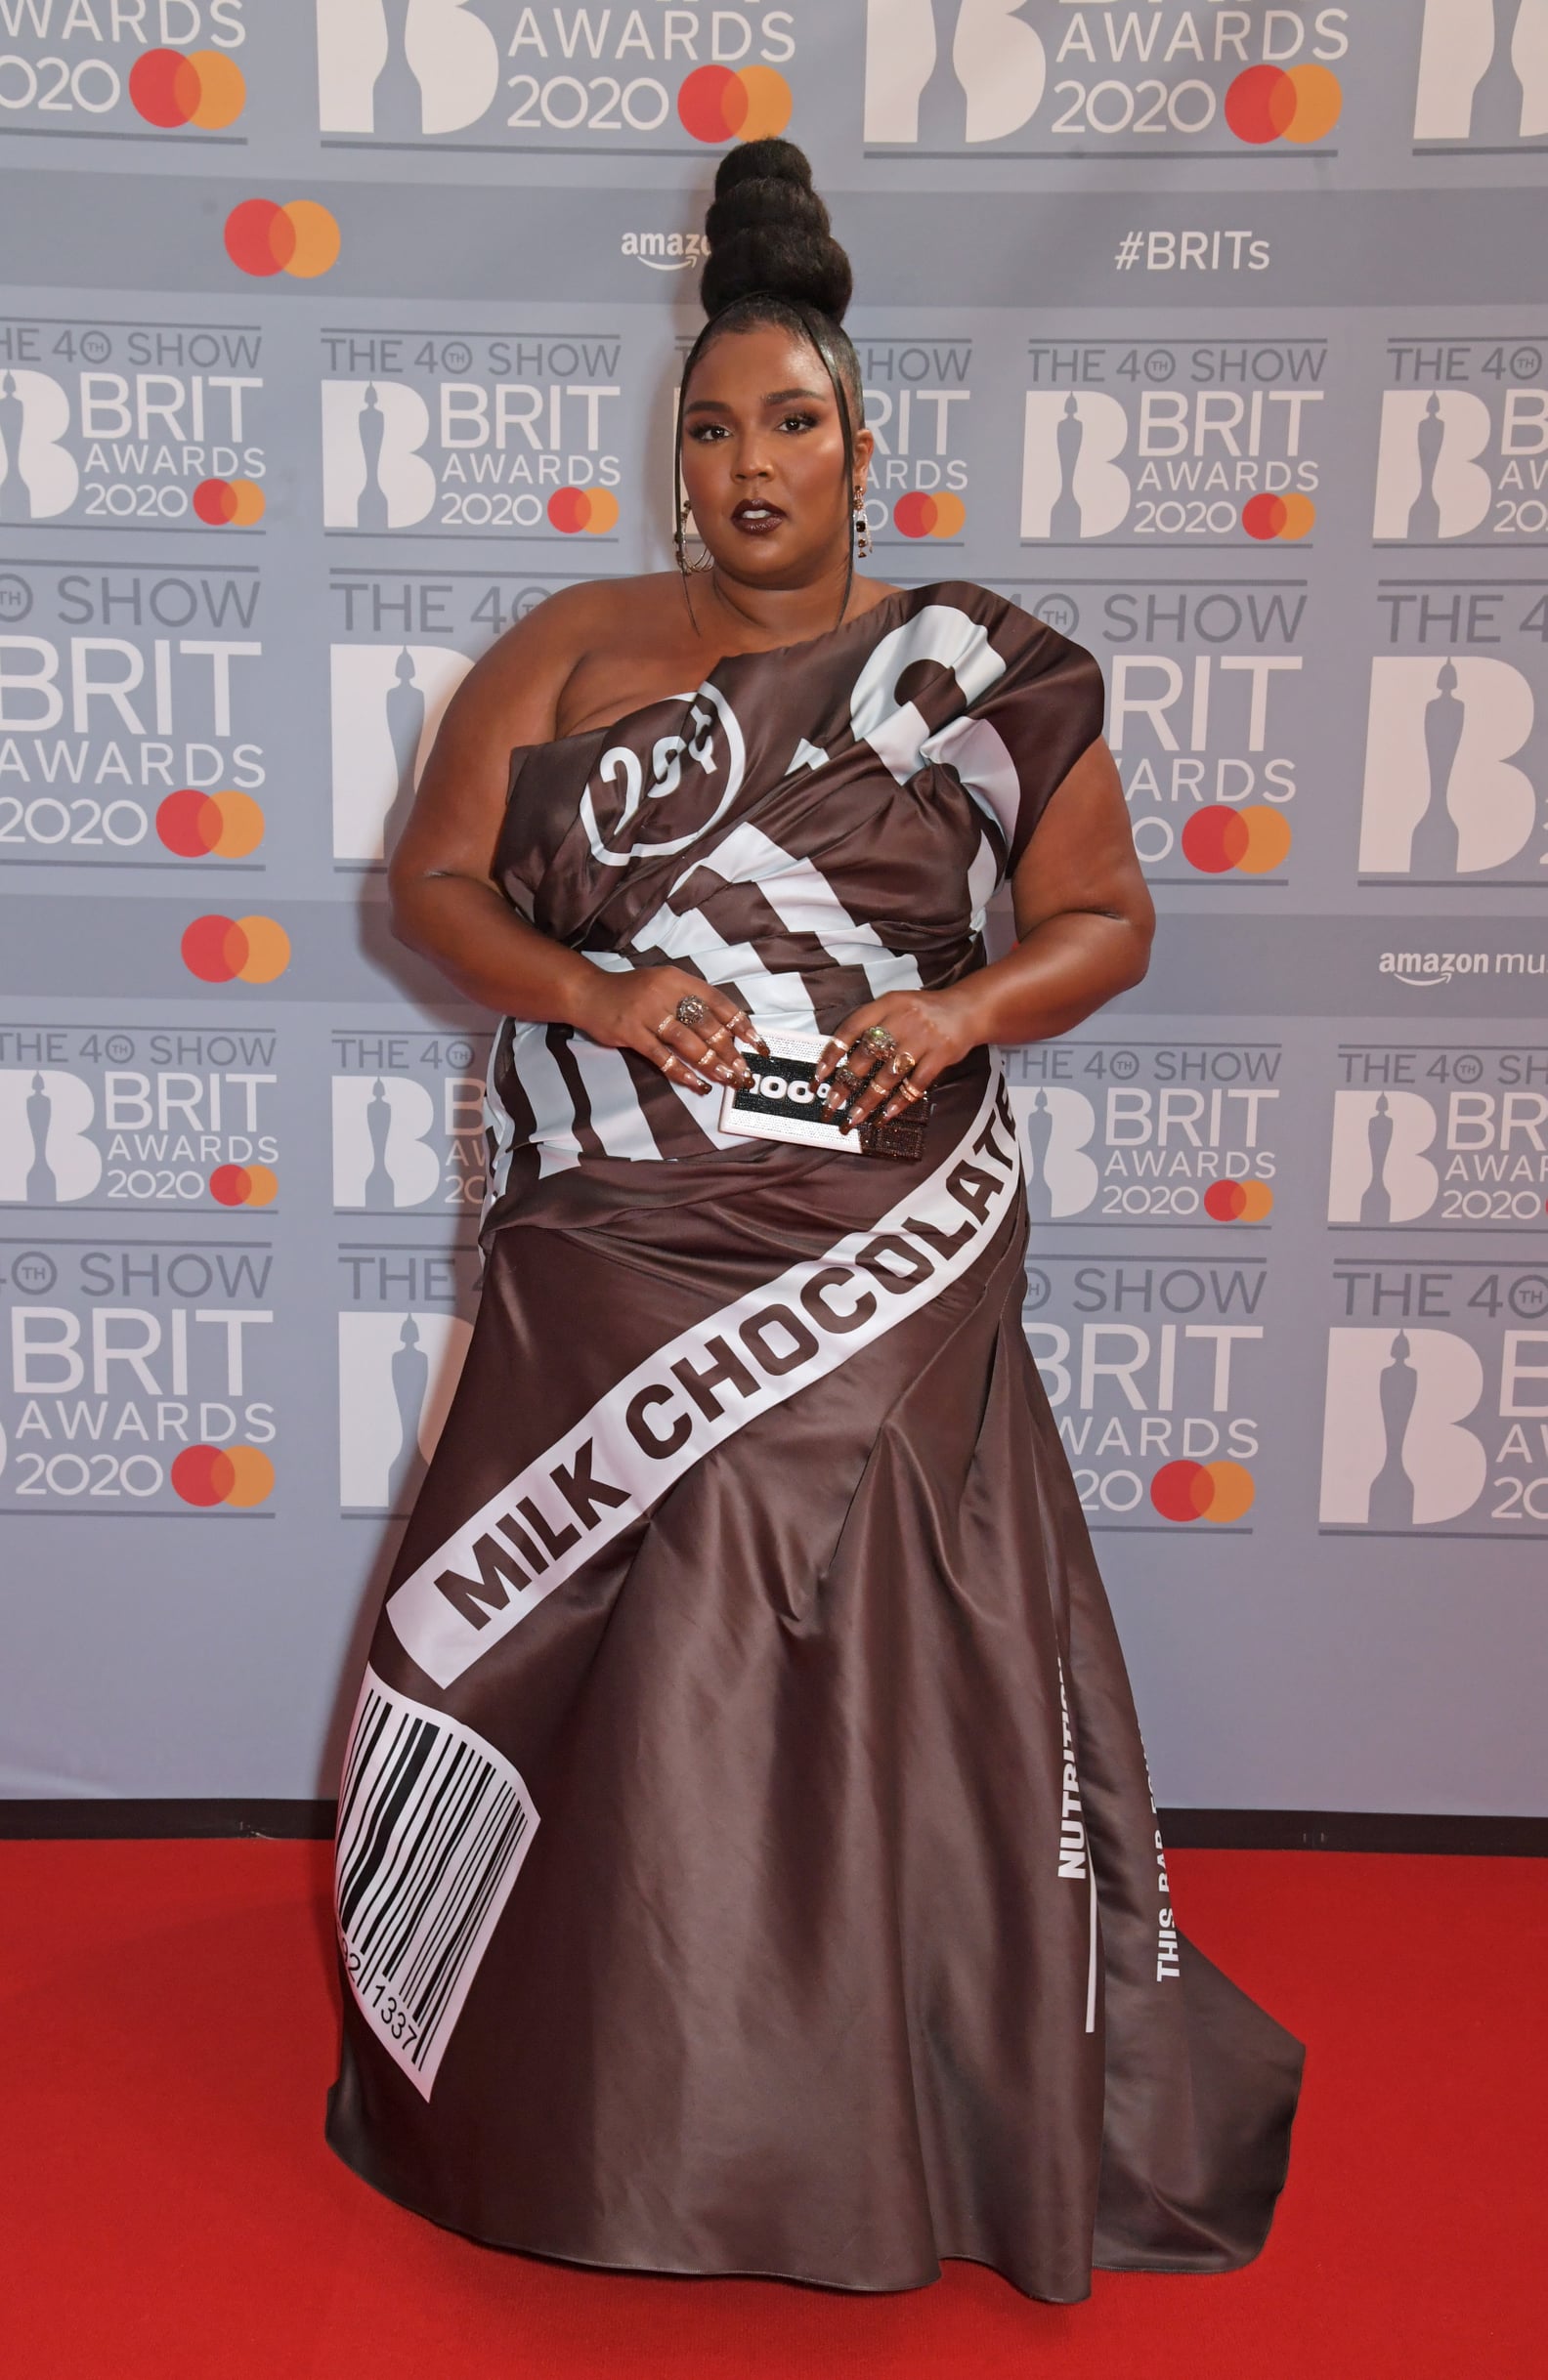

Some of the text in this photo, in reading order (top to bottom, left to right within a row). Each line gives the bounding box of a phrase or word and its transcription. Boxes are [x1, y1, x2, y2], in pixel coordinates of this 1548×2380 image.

[508, 8, 796, 63] AWARDS
[1055, 8, 1349, 63] AWARDS
[507, 74, 669, 131] 2020
[1051, 79, 1217, 134] 2020
[1114, 231, 1270, 271] #BRITs
[127, 332, 262, 368] SHOW
[322, 339, 404, 373] THE
[488, 342, 622, 378] SHOW
[858, 348, 971, 382] HOW
[1028, 350, 1105, 382] THE
[1191, 349, 1327, 382] SHOW
[1387, 348, 1471, 381] THE
[80, 372, 264, 443] BRIT
[440, 383, 621, 451] BRIT
[863, 389, 970, 455] RIT
[1138, 392, 1323, 456] BRIT
[84, 443, 267, 479] AWARDS
[441, 453, 622, 487] AWARDS
[1138, 461, 1319, 491] AWARDS
[85, 483, 189, 518] 2020
[441, 492, 542, 527] 2020
[1134, 501, 1237, 533] 2020
[57, 575, 261, 628] SHOW
[330, 583, 453, 633] THE
[1102, 593, 1308, 644] SHOW
[1377, 594, 1504, 644] THE
[0, 635, 262, 737] BRIT
[1108, 655, 1303, 751] RIT
[0, 739, 266, 787] AWARDS
[1115, 758, 1297, 803] ARDS
[0, 796, 148, 846] 2020
[1379, 953, 1548, 974] amazon mu
[150, 1036, 277, 1067] SHOW
[332, 1039, 409, 1069] THE
[1001, 1050, 1073, 1079] THE
[1154, 1051, 1281, 1082] SHOW
[1338, 1053, 1416, 1083] THE
[105, 1071, 277, 1132] BRIT
[1105, 1087, 1280, 1147] BRIT
[108, 1135, 279, 1164] AWARDS
[1104, 1151, 1276, 1178] AWARDS
[108, 1170, 205, 1201] 2020
[1102, 1185, 1199, 1214] 2020
[1441, 1190, 1541, 1219] 2020
[79, 1252, 273, 1298] SHOW
[338, 1256, 456, 1301] THE
[1072, 1268, 1268, 1314] SHOW
[1333, 1272, 1452, 1317] THE
[11, 1306, 274, 1396] BRIT
[15, 1400, 277, 1443] AWARDS
[1058, 1416, 1259, 1459] WARDS
[15, 1454, 163, 1497] 2020
[433, 1437, 632, 1632] MILK
[374, 1984, 418, 2051] 1337
